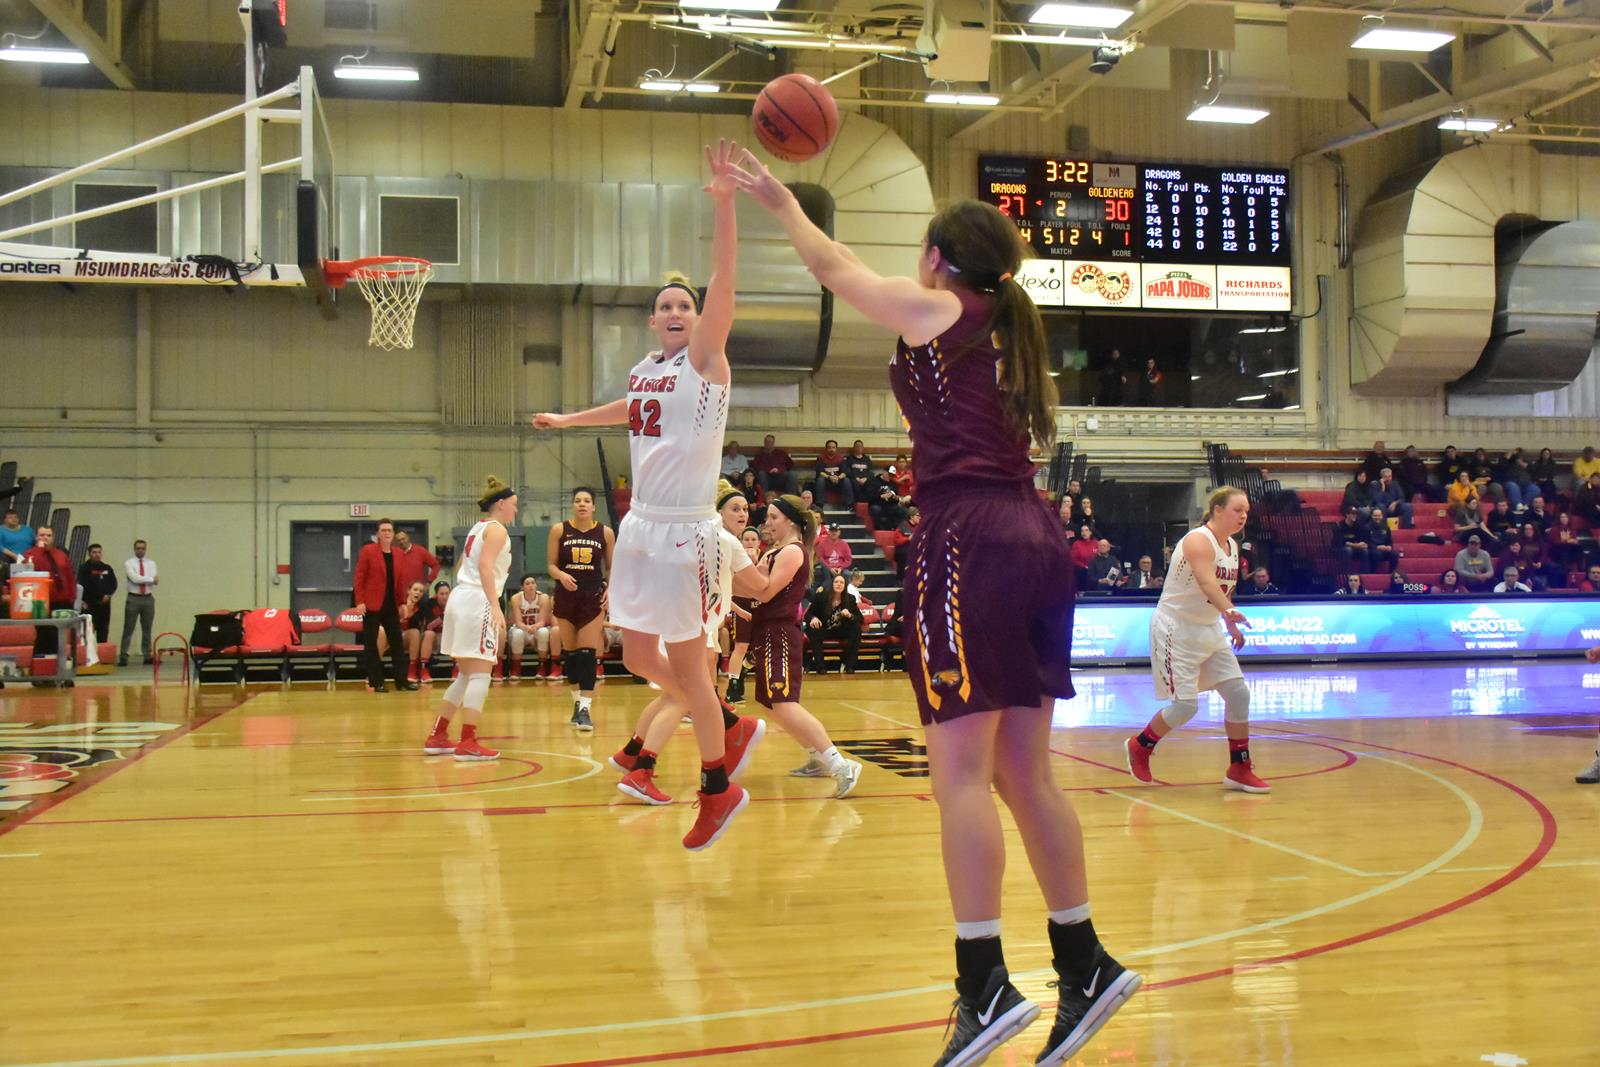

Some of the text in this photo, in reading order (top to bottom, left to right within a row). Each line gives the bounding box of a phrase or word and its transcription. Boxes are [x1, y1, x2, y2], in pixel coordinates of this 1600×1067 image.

[1046, 161, 1088, 182] 3:22
[1145, 170, 1181, 180] DRAGONS
[1222, 173, 1286, 184] GOLDEN EAGLES
[990, 183, 1026, 194] DRAGONS
[1146, 181, 1210, 193] No. Foul Pts.
[1222, 184, 1286, 196] No. Foul Pts.
[1146, 192, 1203, 204] 2 0 0
[1222, 196, 1278, 207] 3 0 5
[998, 196, 1024, 216] 27
[1056, 200, 1066, 216] 2
[1105, 200, 1129, 220] 30
[1146, 204, 1208, 216] 12 0 10
[1222, 208, 1278, 218] 4 0 2
[1146, 216, 1204, 226] 24 1 3
[1222, 219, 1279, 230] 10 1 5
[1021, 229, 1032, 242] 4
[1092, 231, 1102, 244] 4
[1124, 232, 1130, 246] 1
[1146, 228, 1204, 238] 42 0 8
[1222, 230, 1279, 241] 15 1 8
[1147, 239, 1204, 250] 44 0 0
[1223, 242, 1279, 252] 22 0 7
[1016, 274, 1061, 290] dexo
[1148, 280, 1174, 296] PAPA
[1226, 280, 1282, 288] RICHARDS
[628, 375, 677, 392] RAGONS
[628, 399, 662, 437] 42
[354, 504, 367, 515] EXIT
[572, 546, 592, 564] 15
[1450, 619, 1524, 632] MICROTEL
[1073, 626, 1116, 640] OTEL
[1465, 642, 1476, 650] BY
